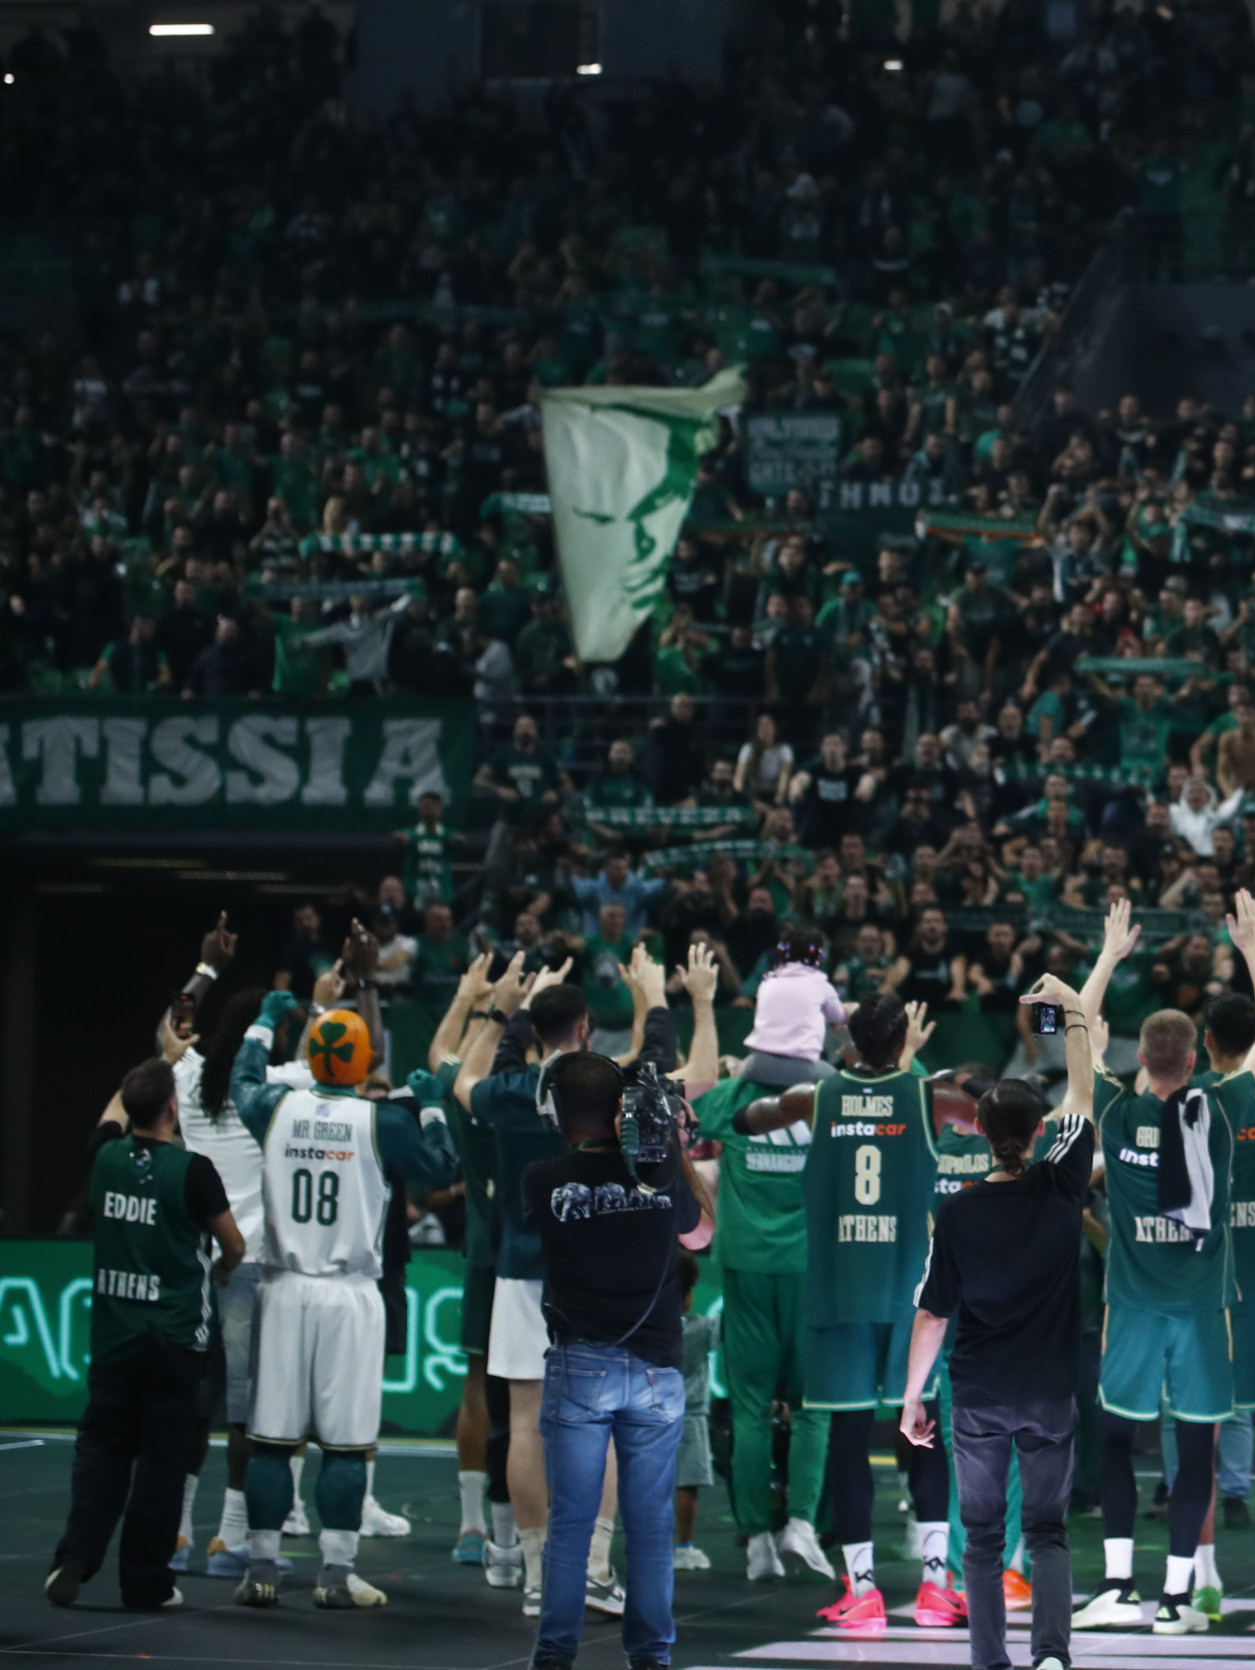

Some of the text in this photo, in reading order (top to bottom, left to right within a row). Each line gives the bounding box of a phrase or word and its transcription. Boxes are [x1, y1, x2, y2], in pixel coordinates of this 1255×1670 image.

[314, 1121, 353, 1142] GREEN
[831, 1121, 907, 1138] instacar
[284, 1143, 355, 1161] instacar
[854, 1144, 882, 1205] 8
[103, 1191, 157, 1226] EDDIE
[291, 1168, 339, 1226] 08
